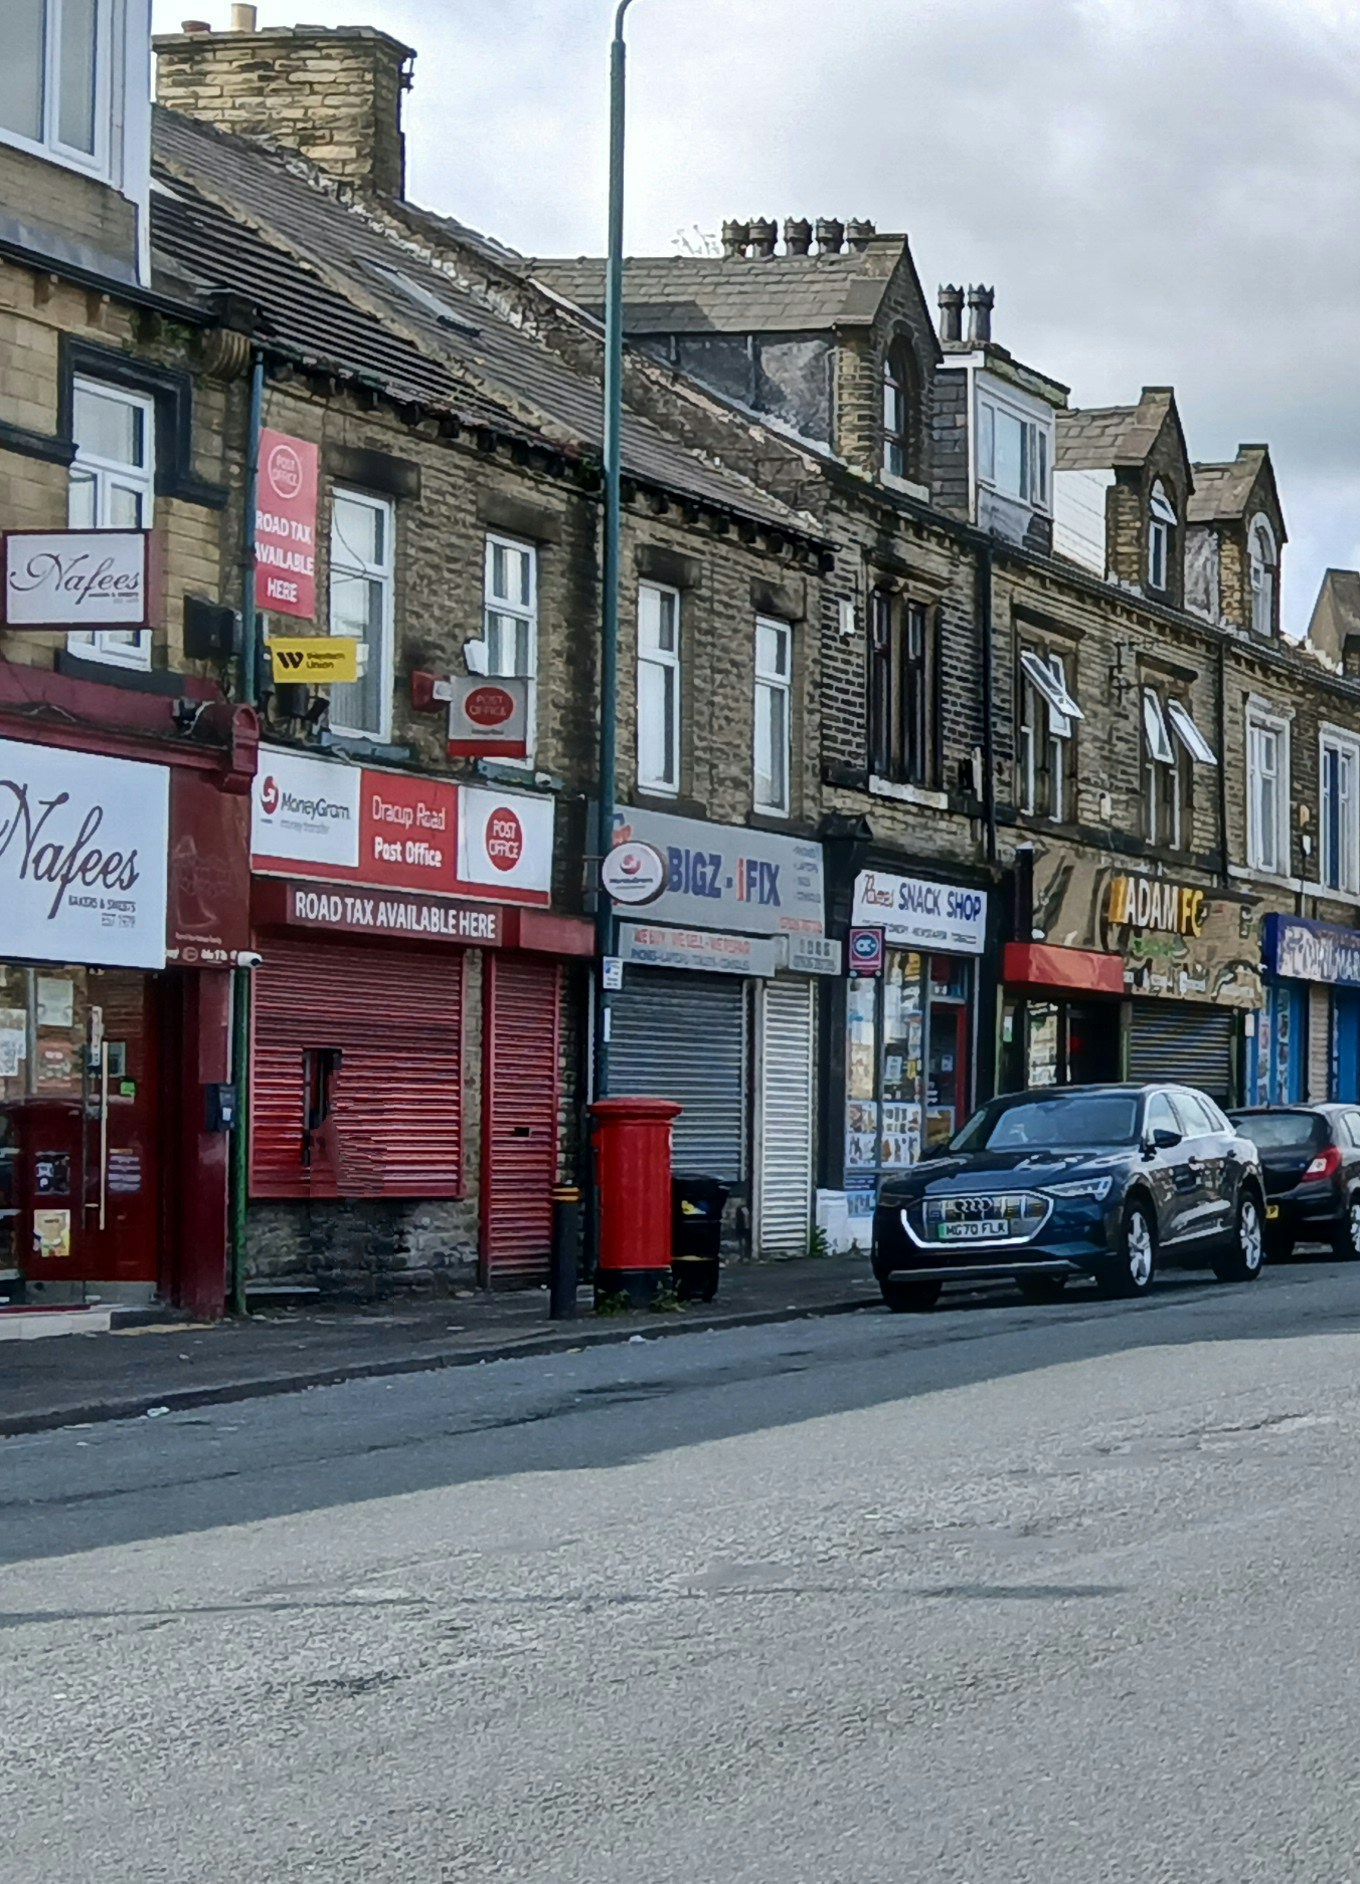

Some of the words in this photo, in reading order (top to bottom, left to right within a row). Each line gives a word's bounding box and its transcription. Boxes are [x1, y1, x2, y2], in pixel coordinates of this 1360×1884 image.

[256, 511, 289, 537] ROAD
[291, 521, 312, 544] TAX
[255, 542, 314, 576] AVAILABLE
[9, 553, 140, 605] Nafees
[267, 577, 298, 602] HERE
[306, 660, 335, 669] Union
[281, 792, 350, 821] MoneyGram
[372, 795, 413, 829] Dracup
[416, 803, 446, 831] Road
[493, 819, 517, 839] POST
[374, 836, 402, 863] Post
[405, 840, 442, 868] Office
[489, 839, 519, 859] OFFICE
[666, 846, 722, 899] BIGZ
[295, 891, 343, 922] ROAD
[344, 897, 373, 926] TAX
[376, 901, 457, 935] AVAILABLE
[459, 910, 497, 939] HERE
[898, 882, 942, 916] SNACK
[946, 890, 982, 922] SHOP
[1124, 877, 1179, 933] ADAM
